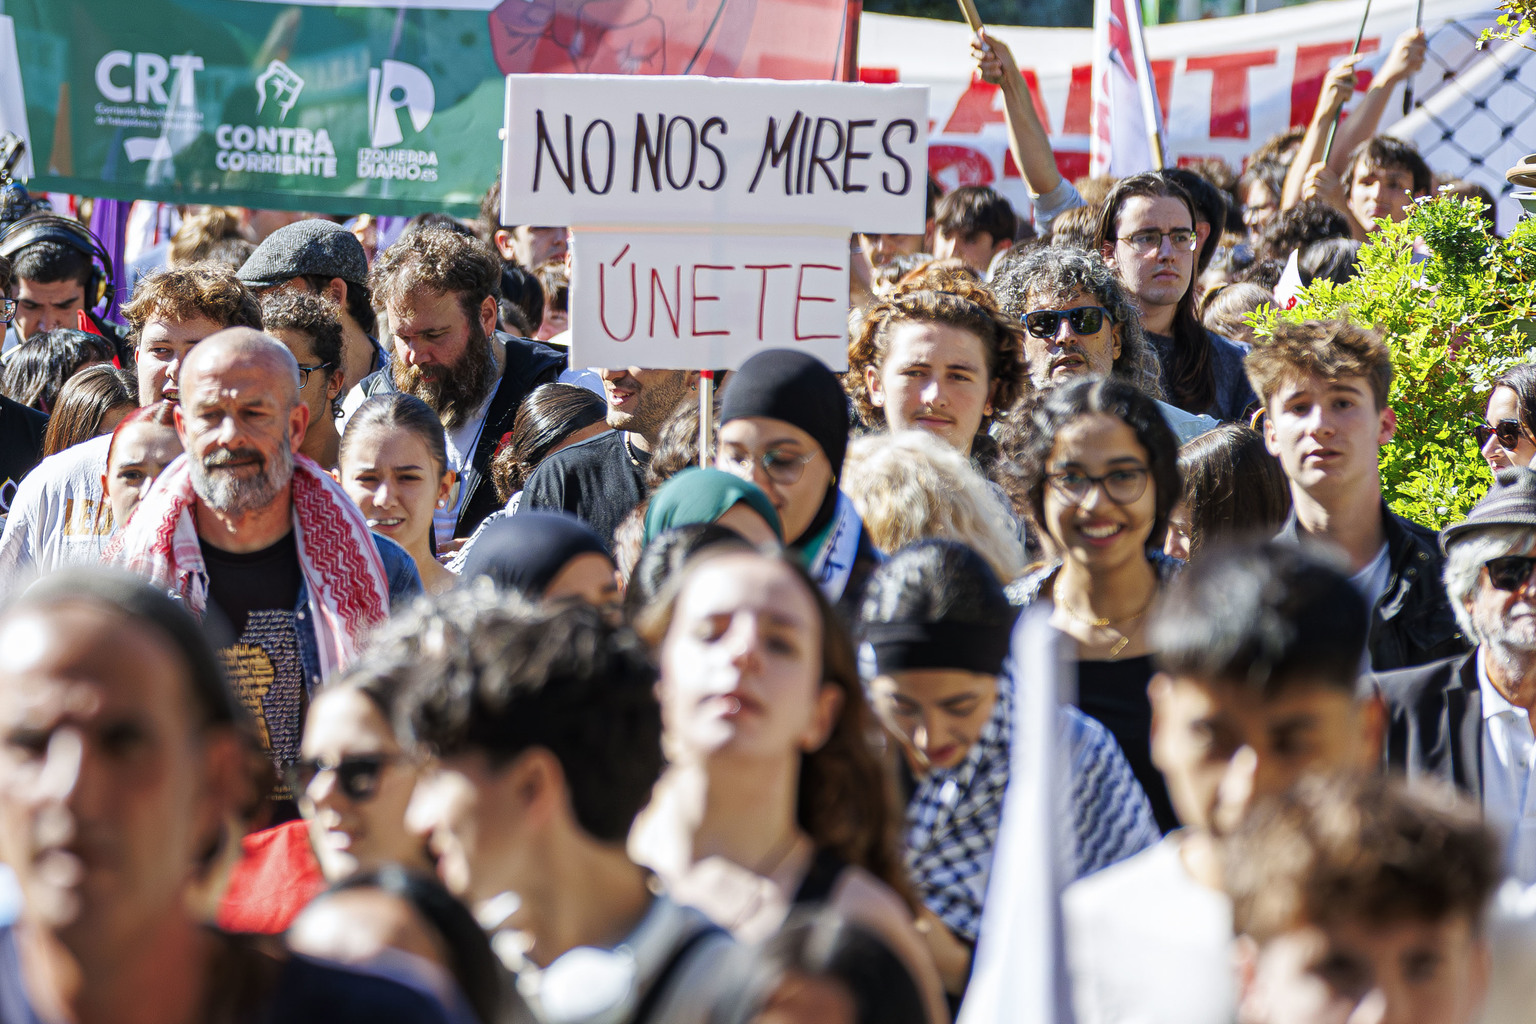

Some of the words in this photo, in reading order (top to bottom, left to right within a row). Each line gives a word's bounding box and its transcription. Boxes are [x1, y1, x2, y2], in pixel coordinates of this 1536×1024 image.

[94, 49, 205, 106] CRT
[215, 124, 335, 156] CONTRA
[357, 148, 438, 167] IZQUIERDA
[533, 108, 618, 197] NO
[631, 111, 728, 194] NOS
[748, 108, 920, 198] MIRES
[215, 151, 337, 178] CORRIENTE
[597, 243, 843, 344] ÚNETE
